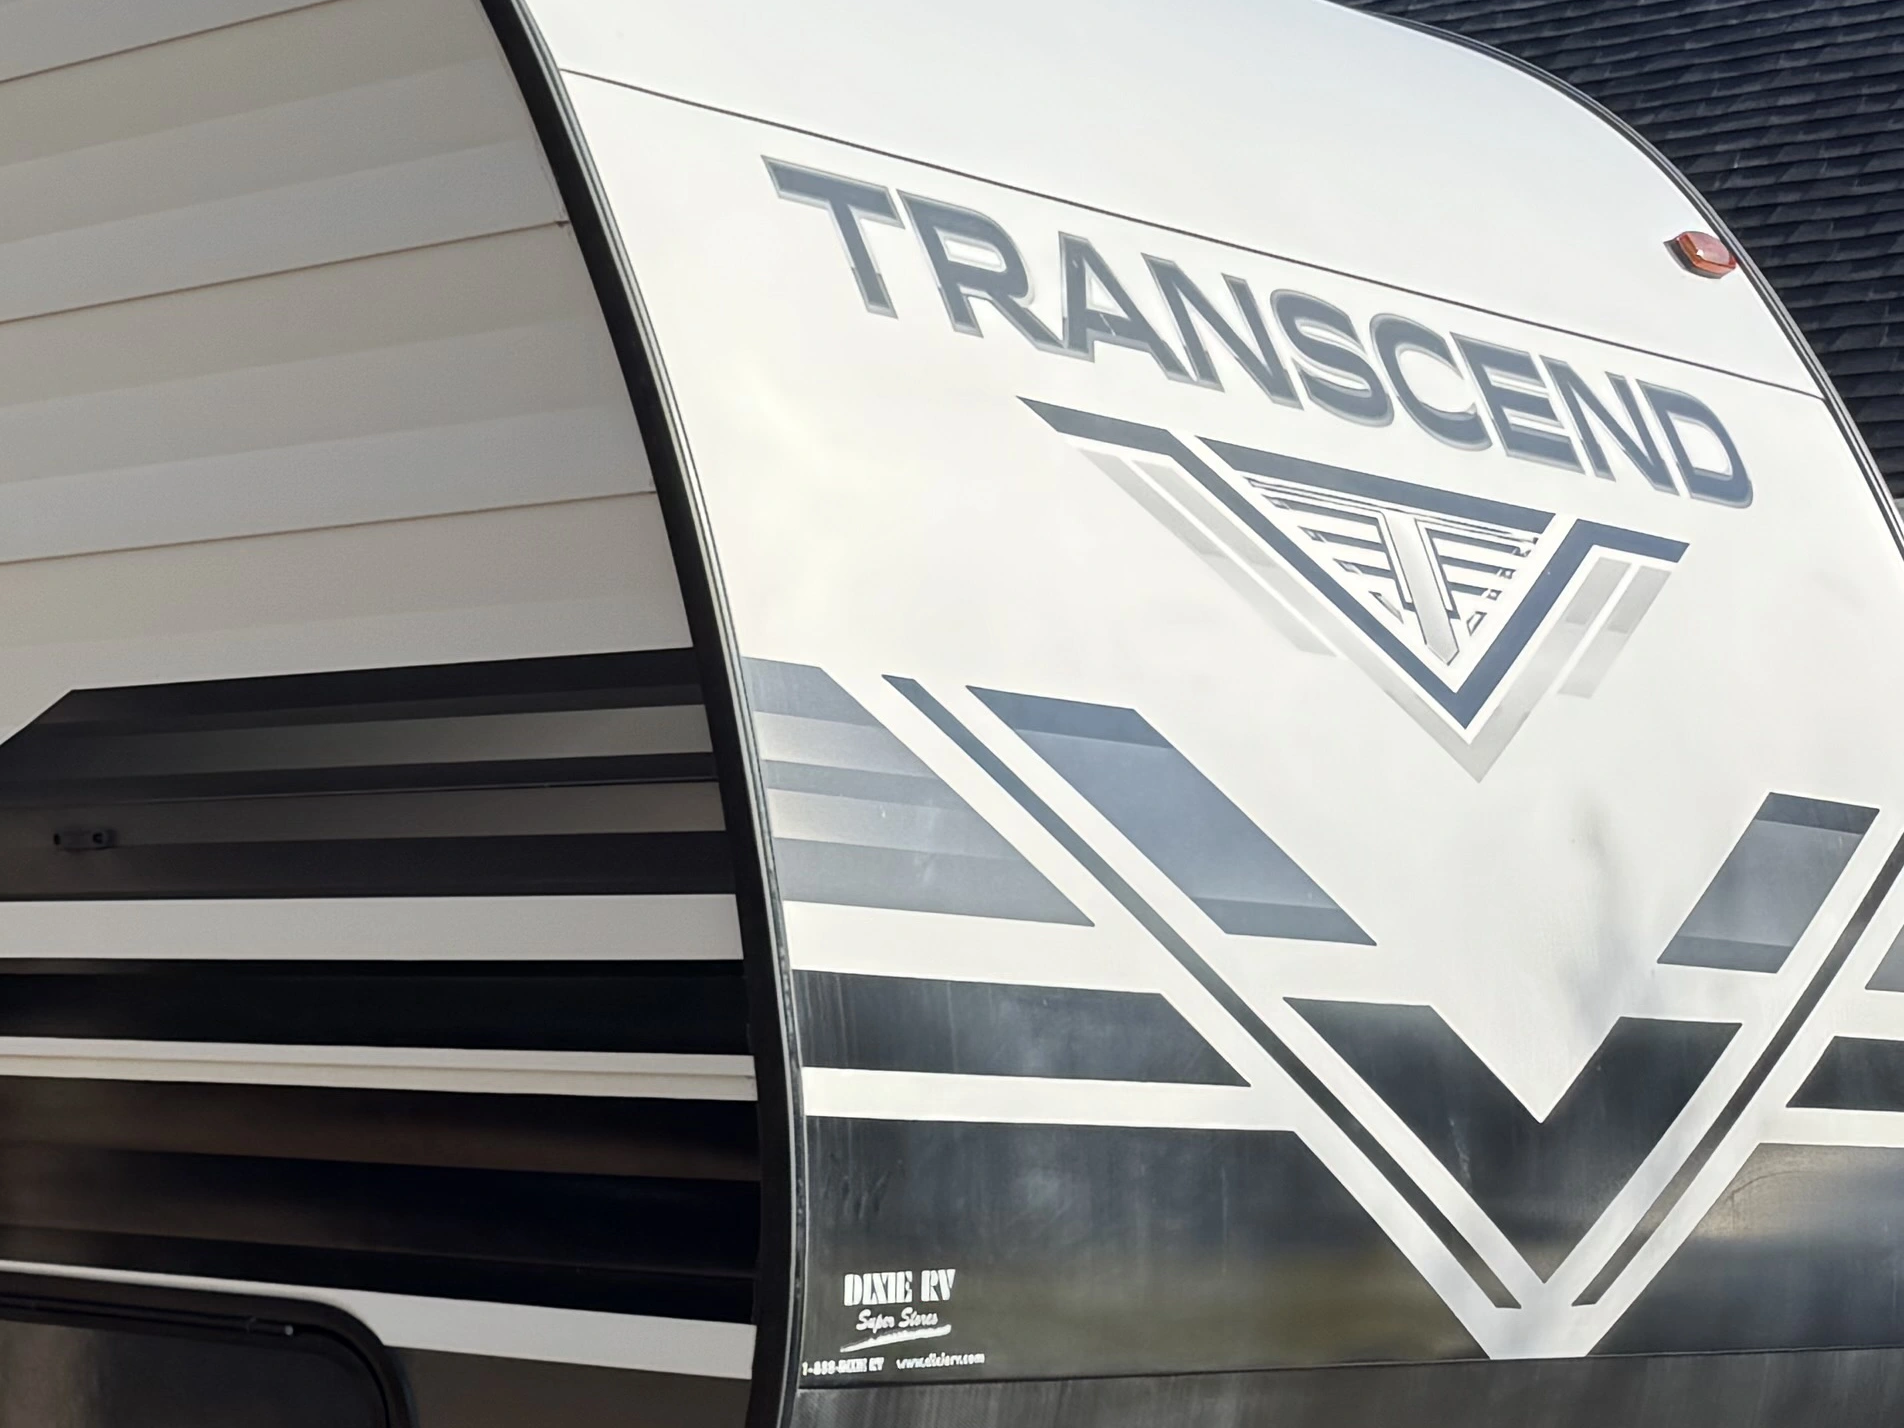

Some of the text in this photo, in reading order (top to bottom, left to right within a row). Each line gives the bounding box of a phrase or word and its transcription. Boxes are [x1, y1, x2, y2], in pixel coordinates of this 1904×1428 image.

[762, 155, 1754, 509] TRANSCEND
[844, 1269, 956, 1307] DIXIE RV
[856, 1307, 939, 1334] Super Stores
